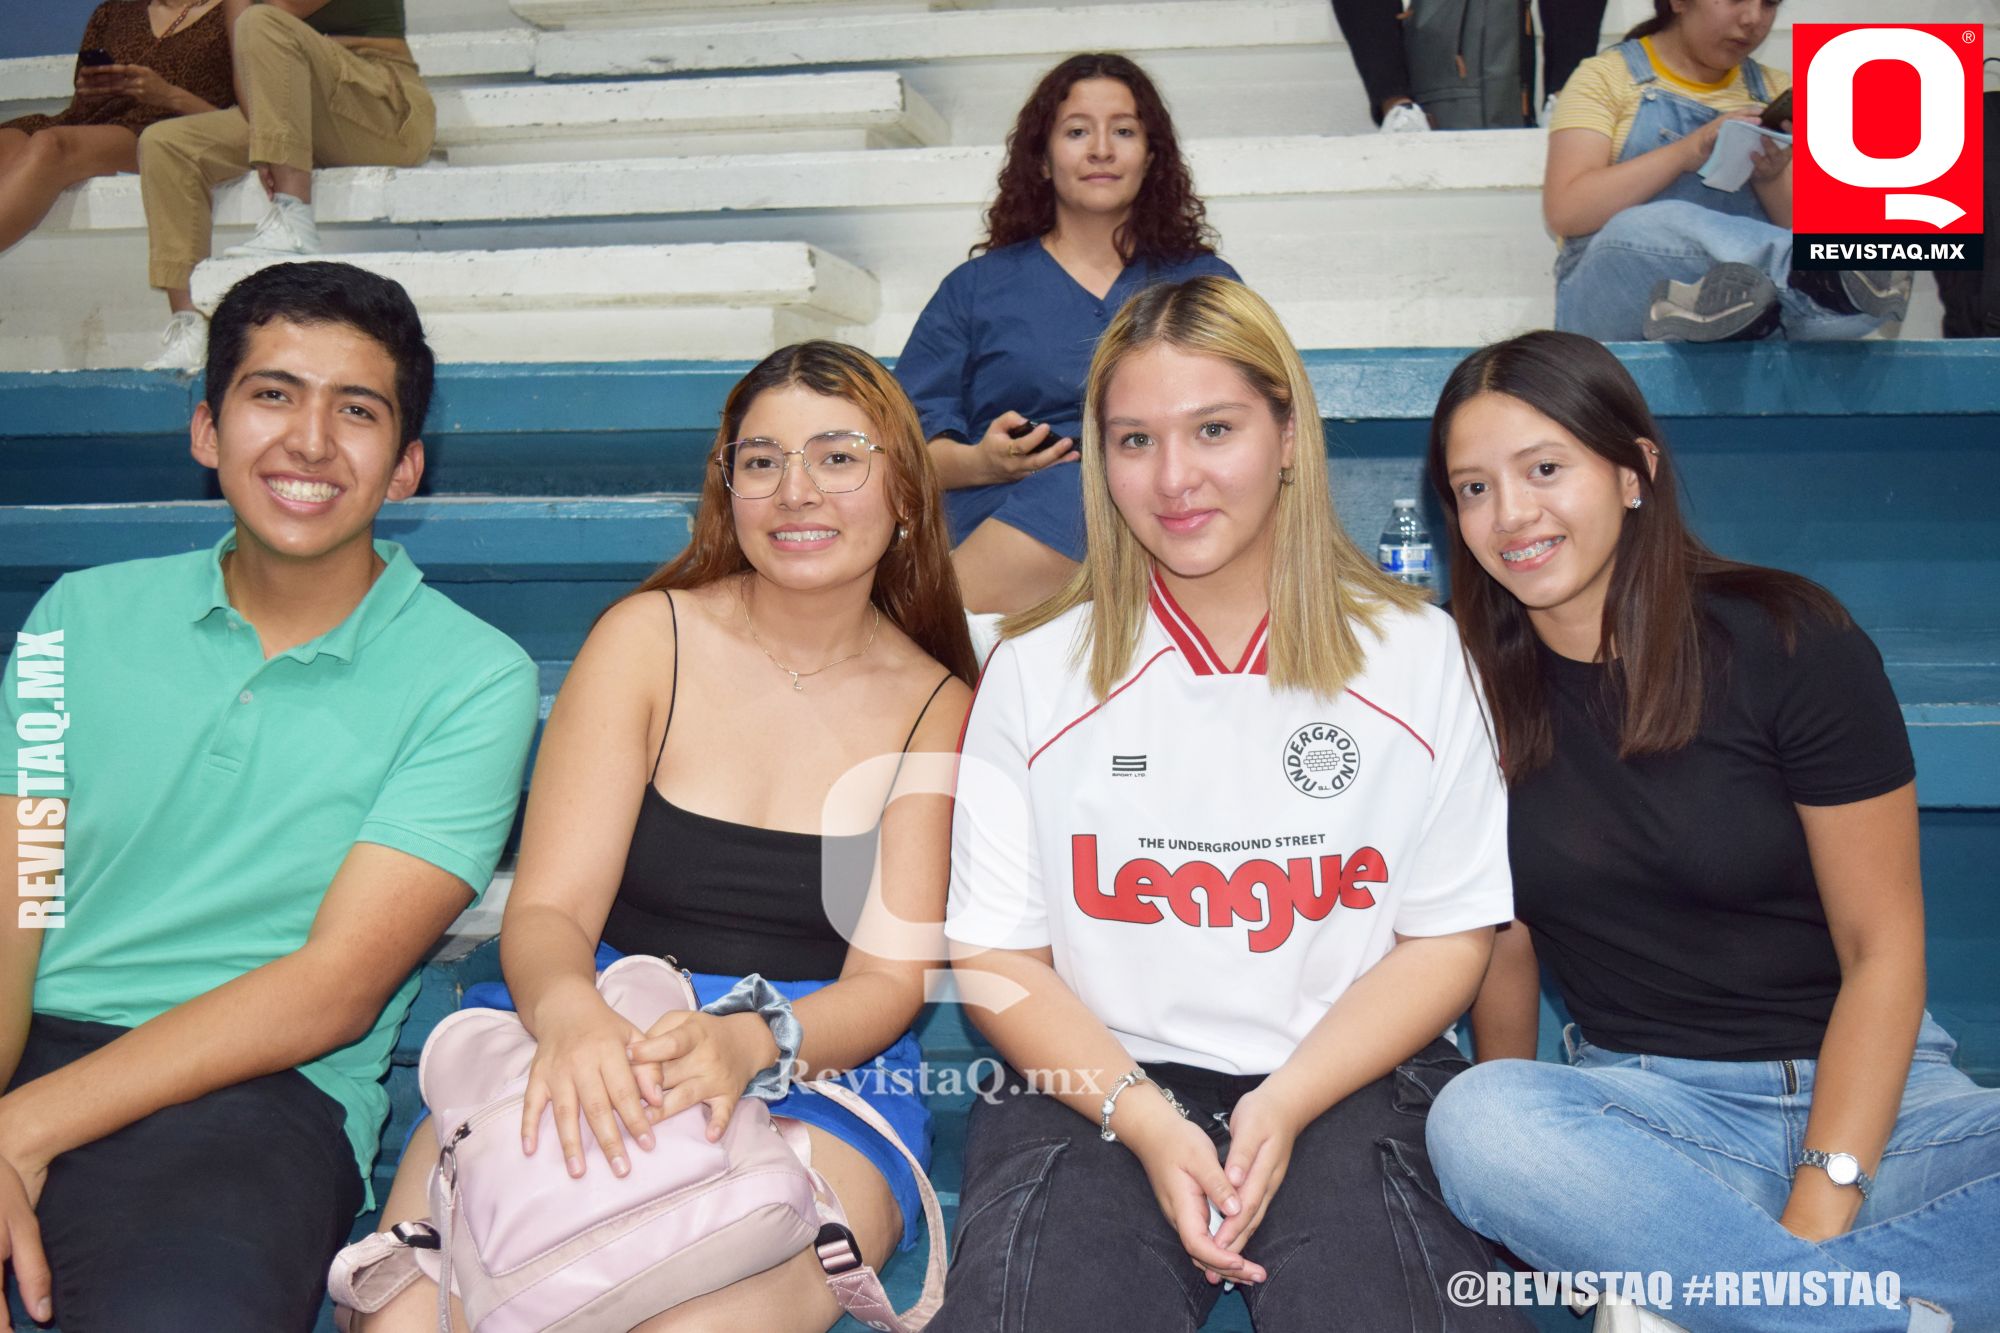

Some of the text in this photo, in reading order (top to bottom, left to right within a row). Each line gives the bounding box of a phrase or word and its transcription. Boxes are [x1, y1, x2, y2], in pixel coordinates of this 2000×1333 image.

[1287, 726, 1357, 792] UNDERGROUND
[1138, 833, 1326, 853] THE UNDERGROUND STREET
[1071, 834, 1389, 953] League
